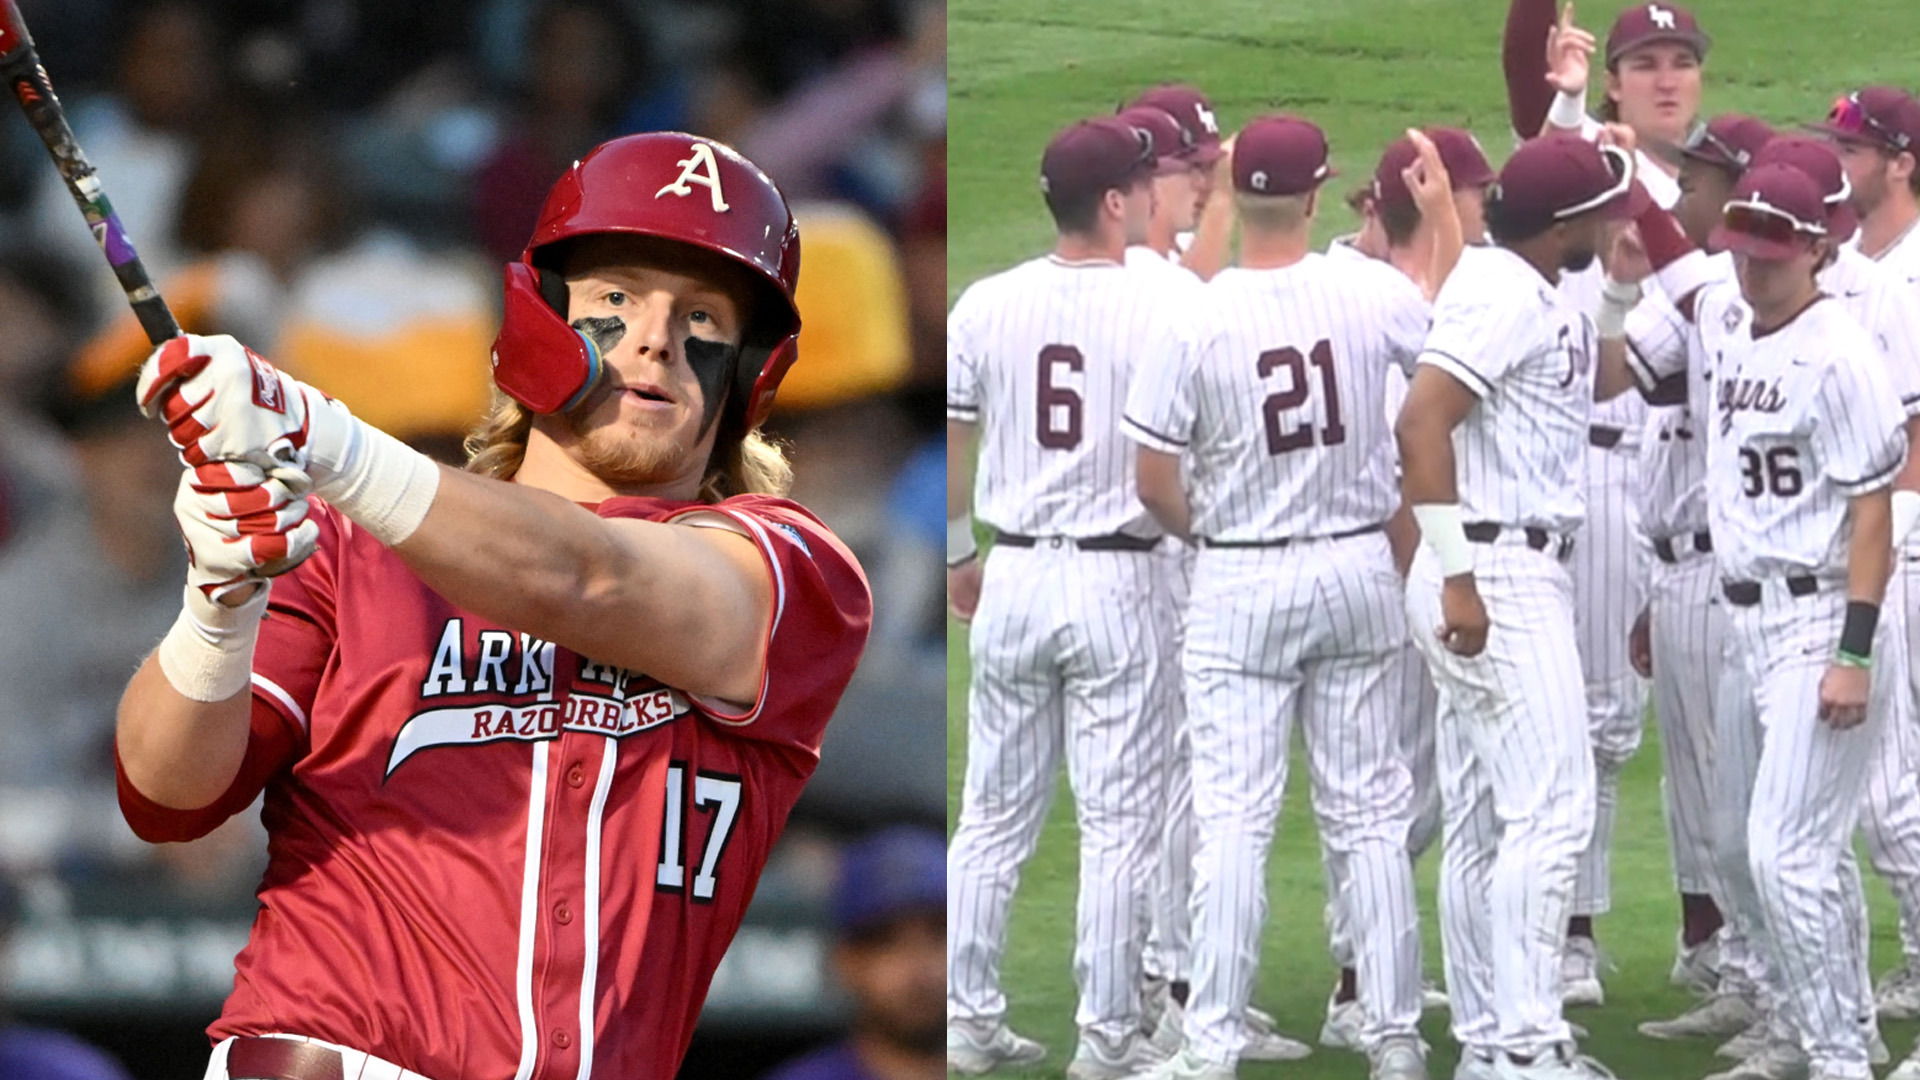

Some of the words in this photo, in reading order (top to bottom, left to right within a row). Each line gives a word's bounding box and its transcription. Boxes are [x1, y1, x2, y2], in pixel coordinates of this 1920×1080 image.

[654, 143, 730, 213] A
[1036, 343, 1085, 452] 6
[1256, 338, 1346, 457] 21
[1738, 446, 1803, 498] 36
[471, 689, 674, 740] RAZORBCKS
[656, 761, 742, 902] 17
